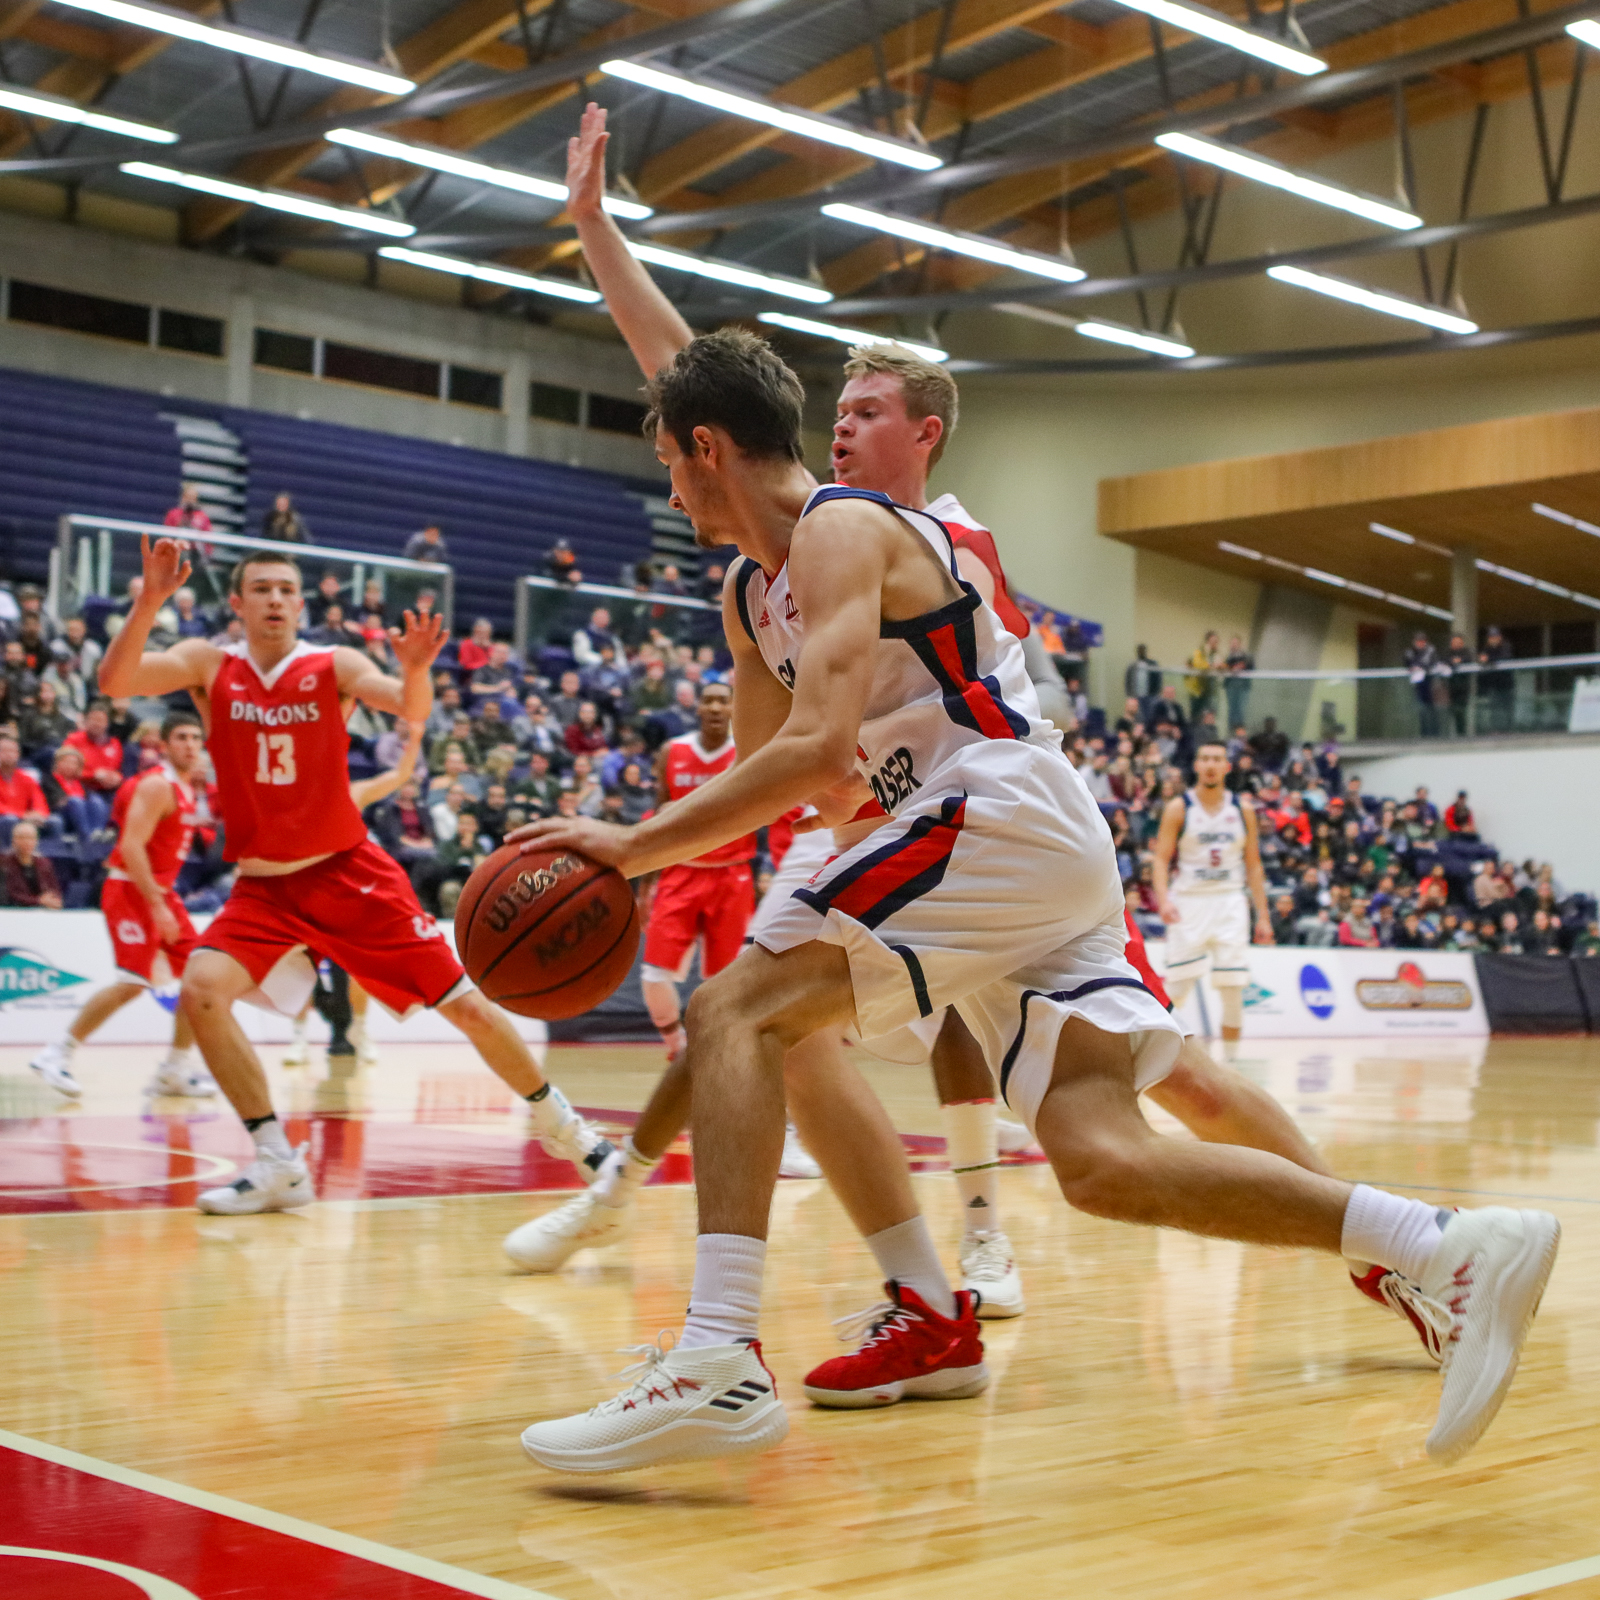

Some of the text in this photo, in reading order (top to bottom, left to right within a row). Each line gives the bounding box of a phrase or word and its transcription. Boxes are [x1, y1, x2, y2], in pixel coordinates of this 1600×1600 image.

[255, 731, 297, 785] 13
[868, 747, 923, 815] ASER
[1210, 848, 1222, 868] 5
[484, 853, 585, 933] Wilson
[0, 967, 60, 990] nac
